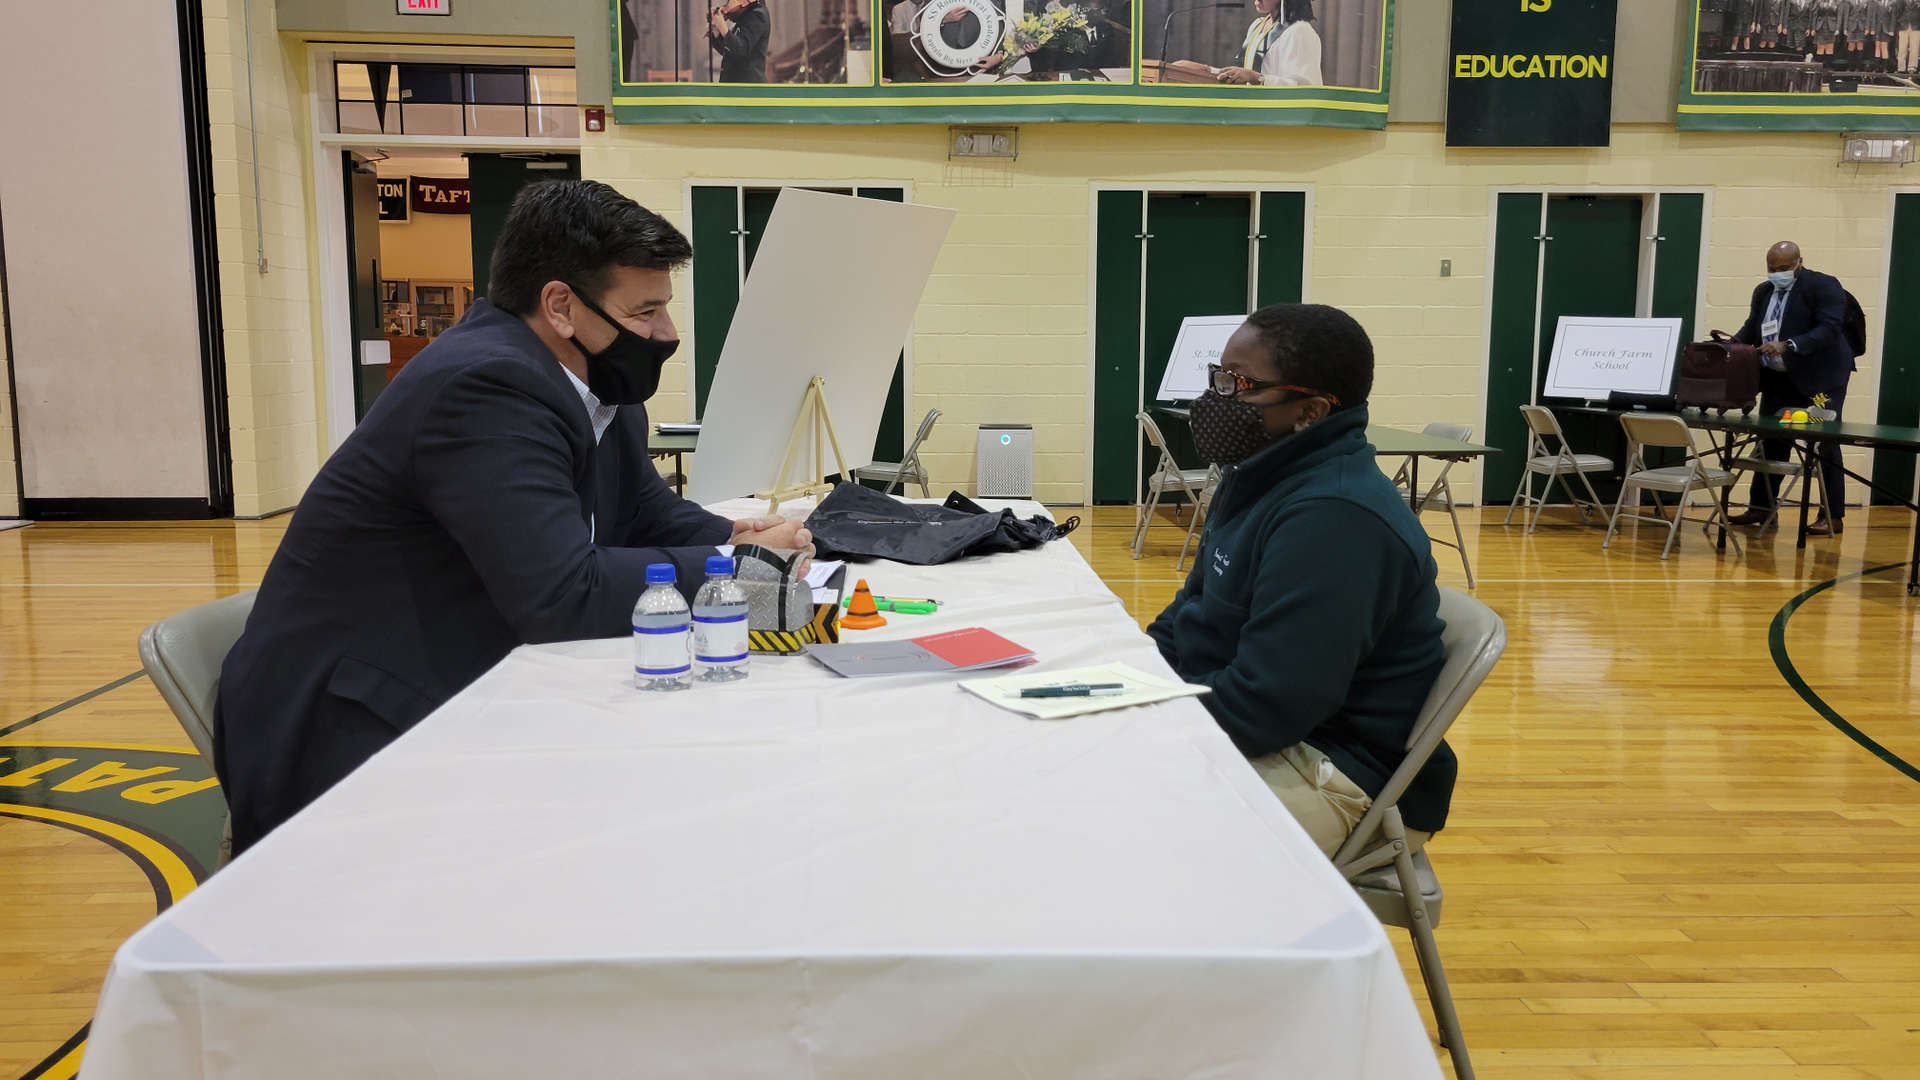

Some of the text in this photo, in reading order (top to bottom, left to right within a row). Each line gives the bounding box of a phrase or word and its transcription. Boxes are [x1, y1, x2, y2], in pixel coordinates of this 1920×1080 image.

[1455, 54, 1607, 78] EDUCATION
[1574, 347, 1653, 359] Church Farm
[1592, 360, 1631, 370] School
[0, 757, 220, 804] PAT
